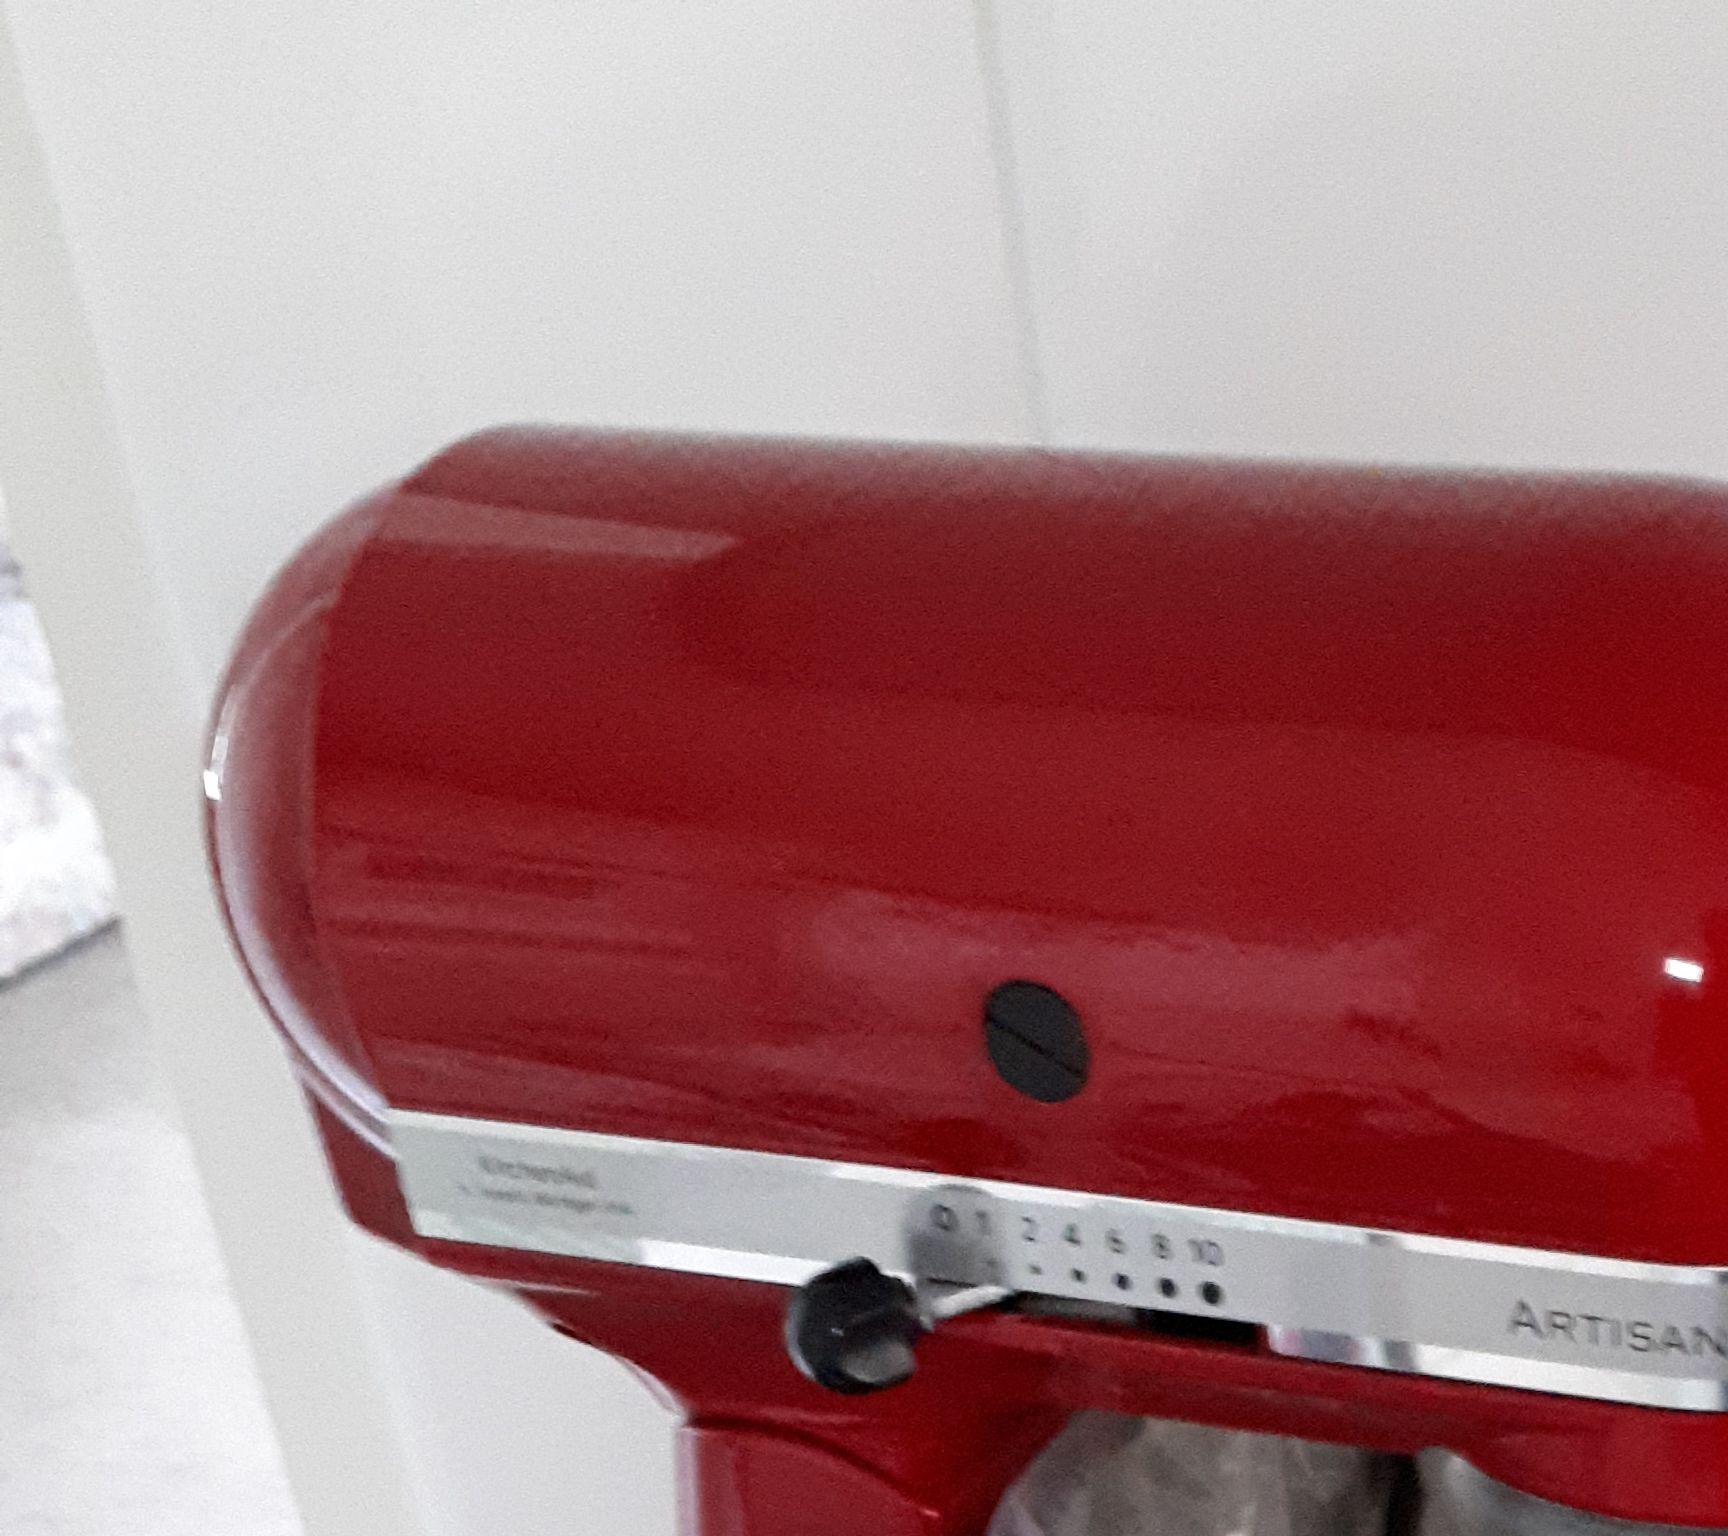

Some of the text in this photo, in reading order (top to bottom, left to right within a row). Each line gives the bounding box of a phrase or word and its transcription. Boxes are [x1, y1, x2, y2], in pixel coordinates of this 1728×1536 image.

[1021, 1215, 1039, 1243] 2
[1062, 1221, 1083, 1247] 4
[1105, 1227, 1126, 1255] 6
[1151, 1232, 1172, 1261] 8
[1187, 1237, 1225, 1267] 10
